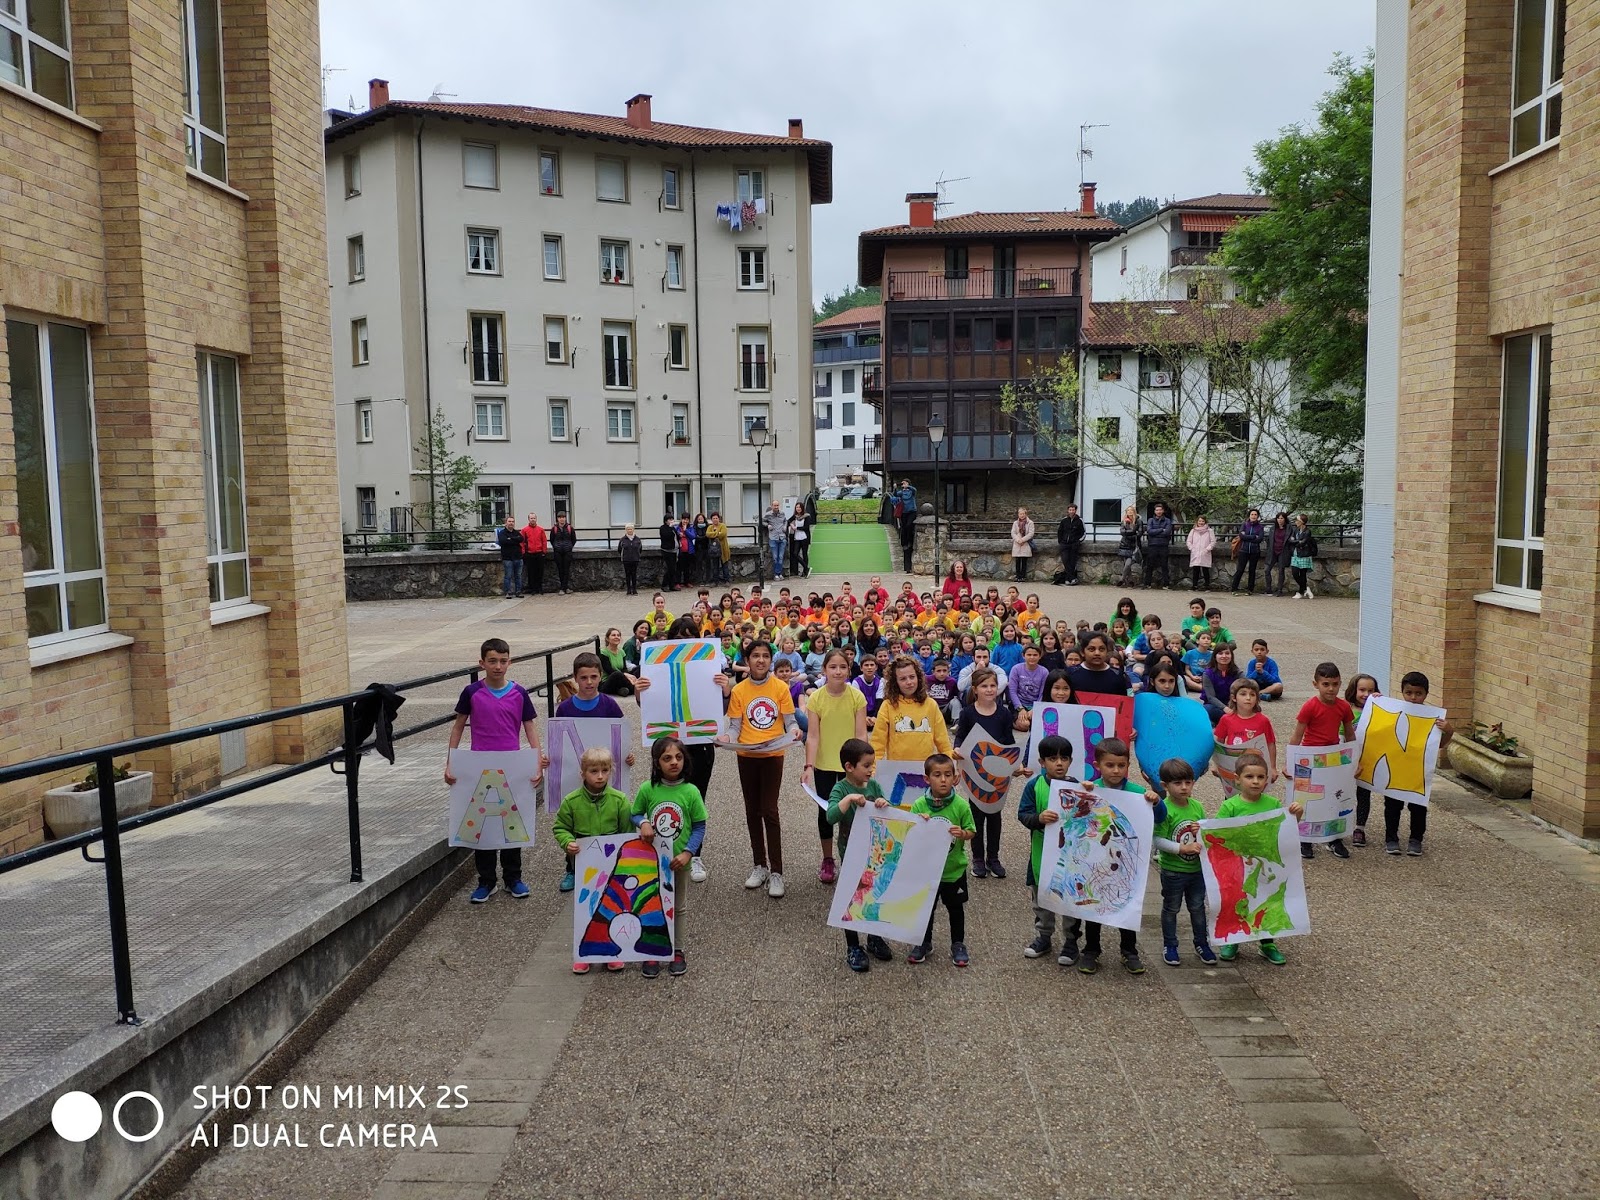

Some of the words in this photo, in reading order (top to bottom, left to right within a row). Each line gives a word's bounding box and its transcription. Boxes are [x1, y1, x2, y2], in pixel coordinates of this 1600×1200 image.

[1356, 702, 1440, 796] N
[454, 769, 530, 844] A
[578, 837, 674, 958] A
